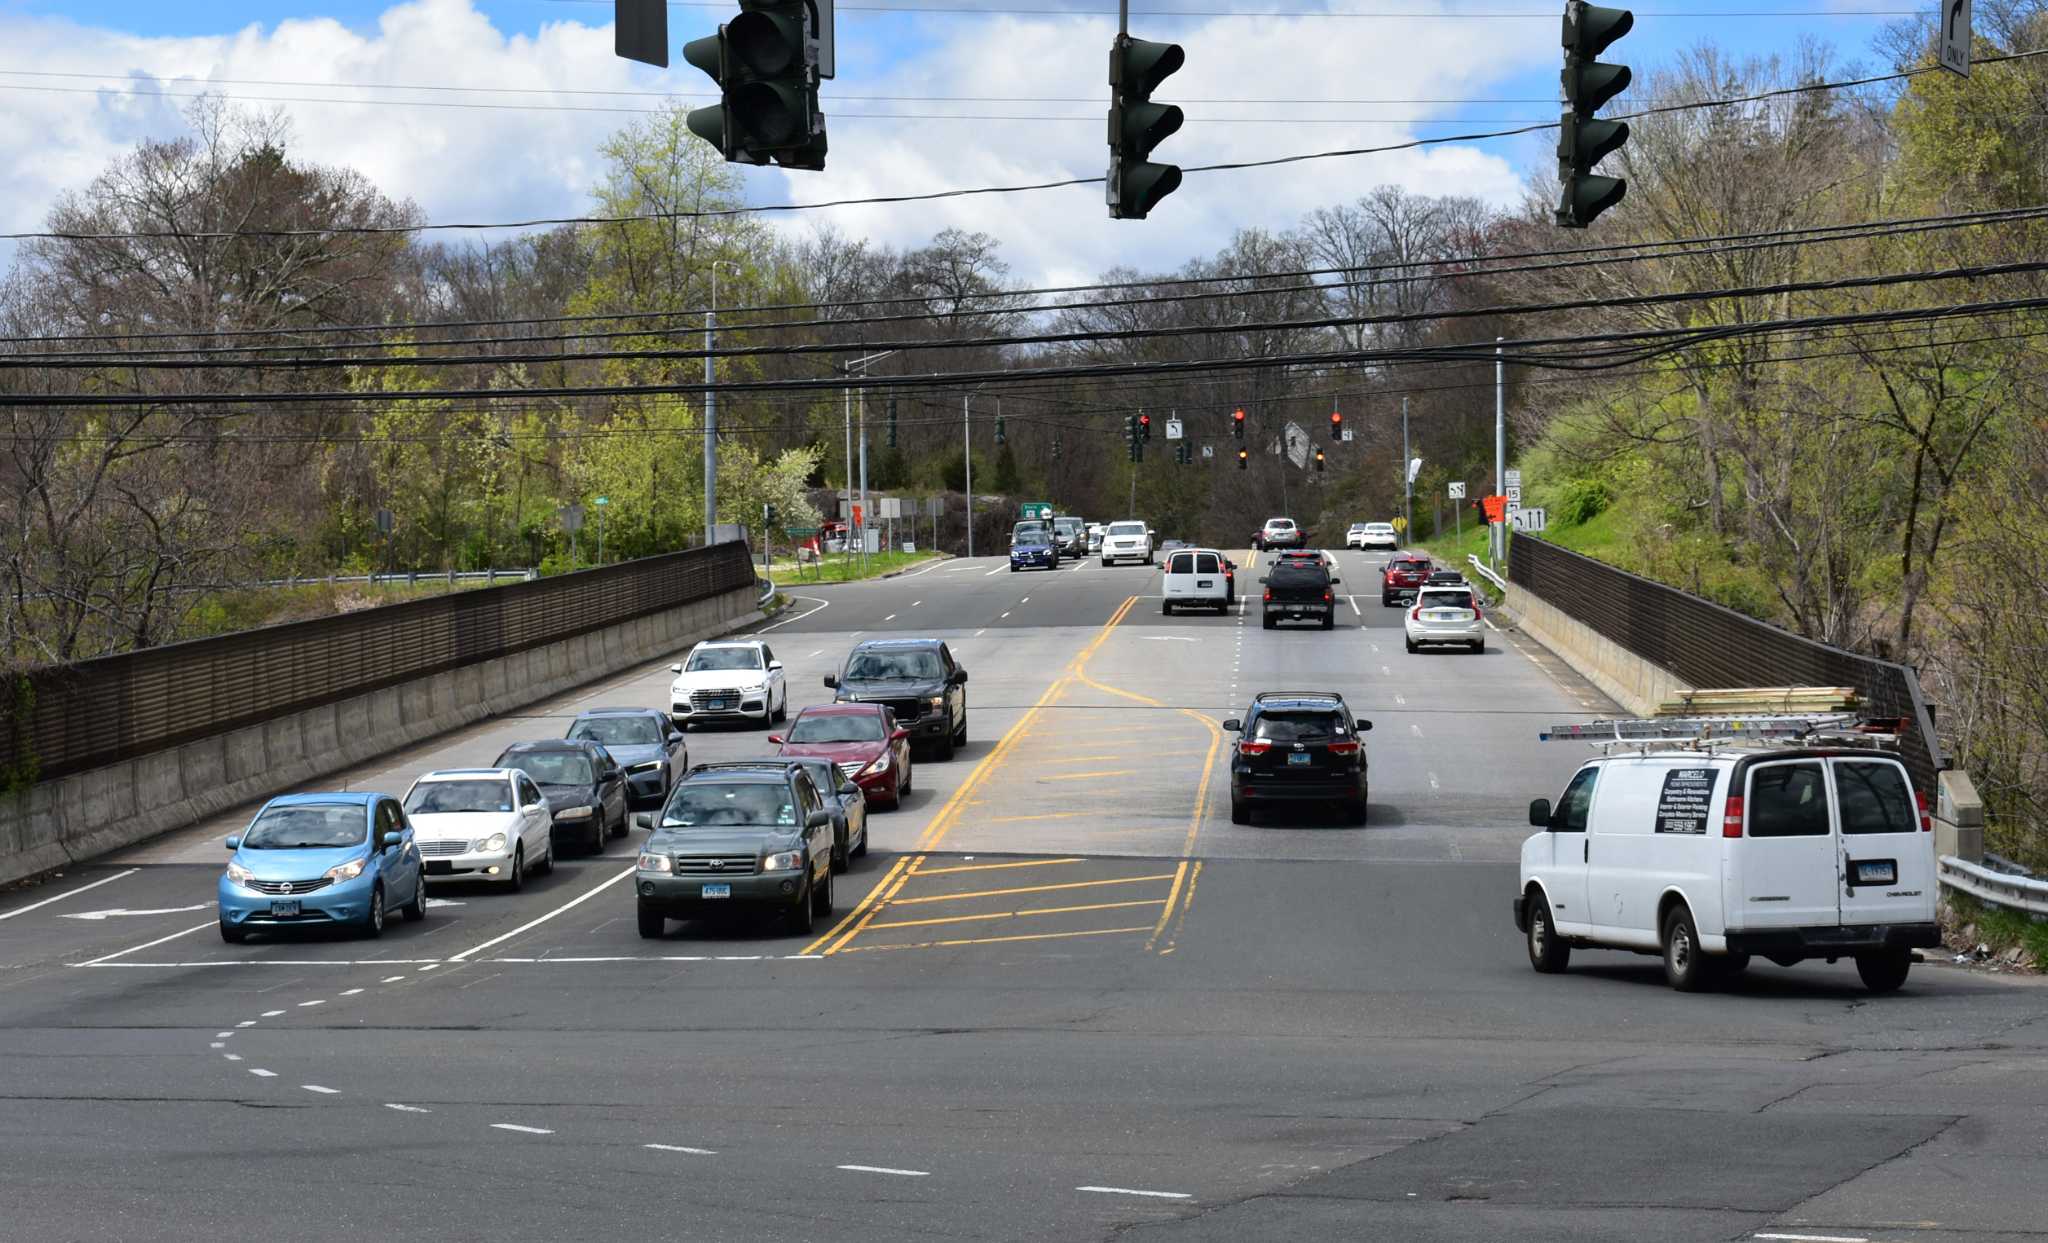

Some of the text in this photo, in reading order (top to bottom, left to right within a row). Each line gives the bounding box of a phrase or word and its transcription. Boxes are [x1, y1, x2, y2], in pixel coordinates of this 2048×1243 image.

[1946, 44, 1966, 67] ONLY
[1508, 489, 1518, 499] 15
[1679, 770, 1705, 778] MARCELO
[1886, 890, 1922, 898] CHEVROLET
